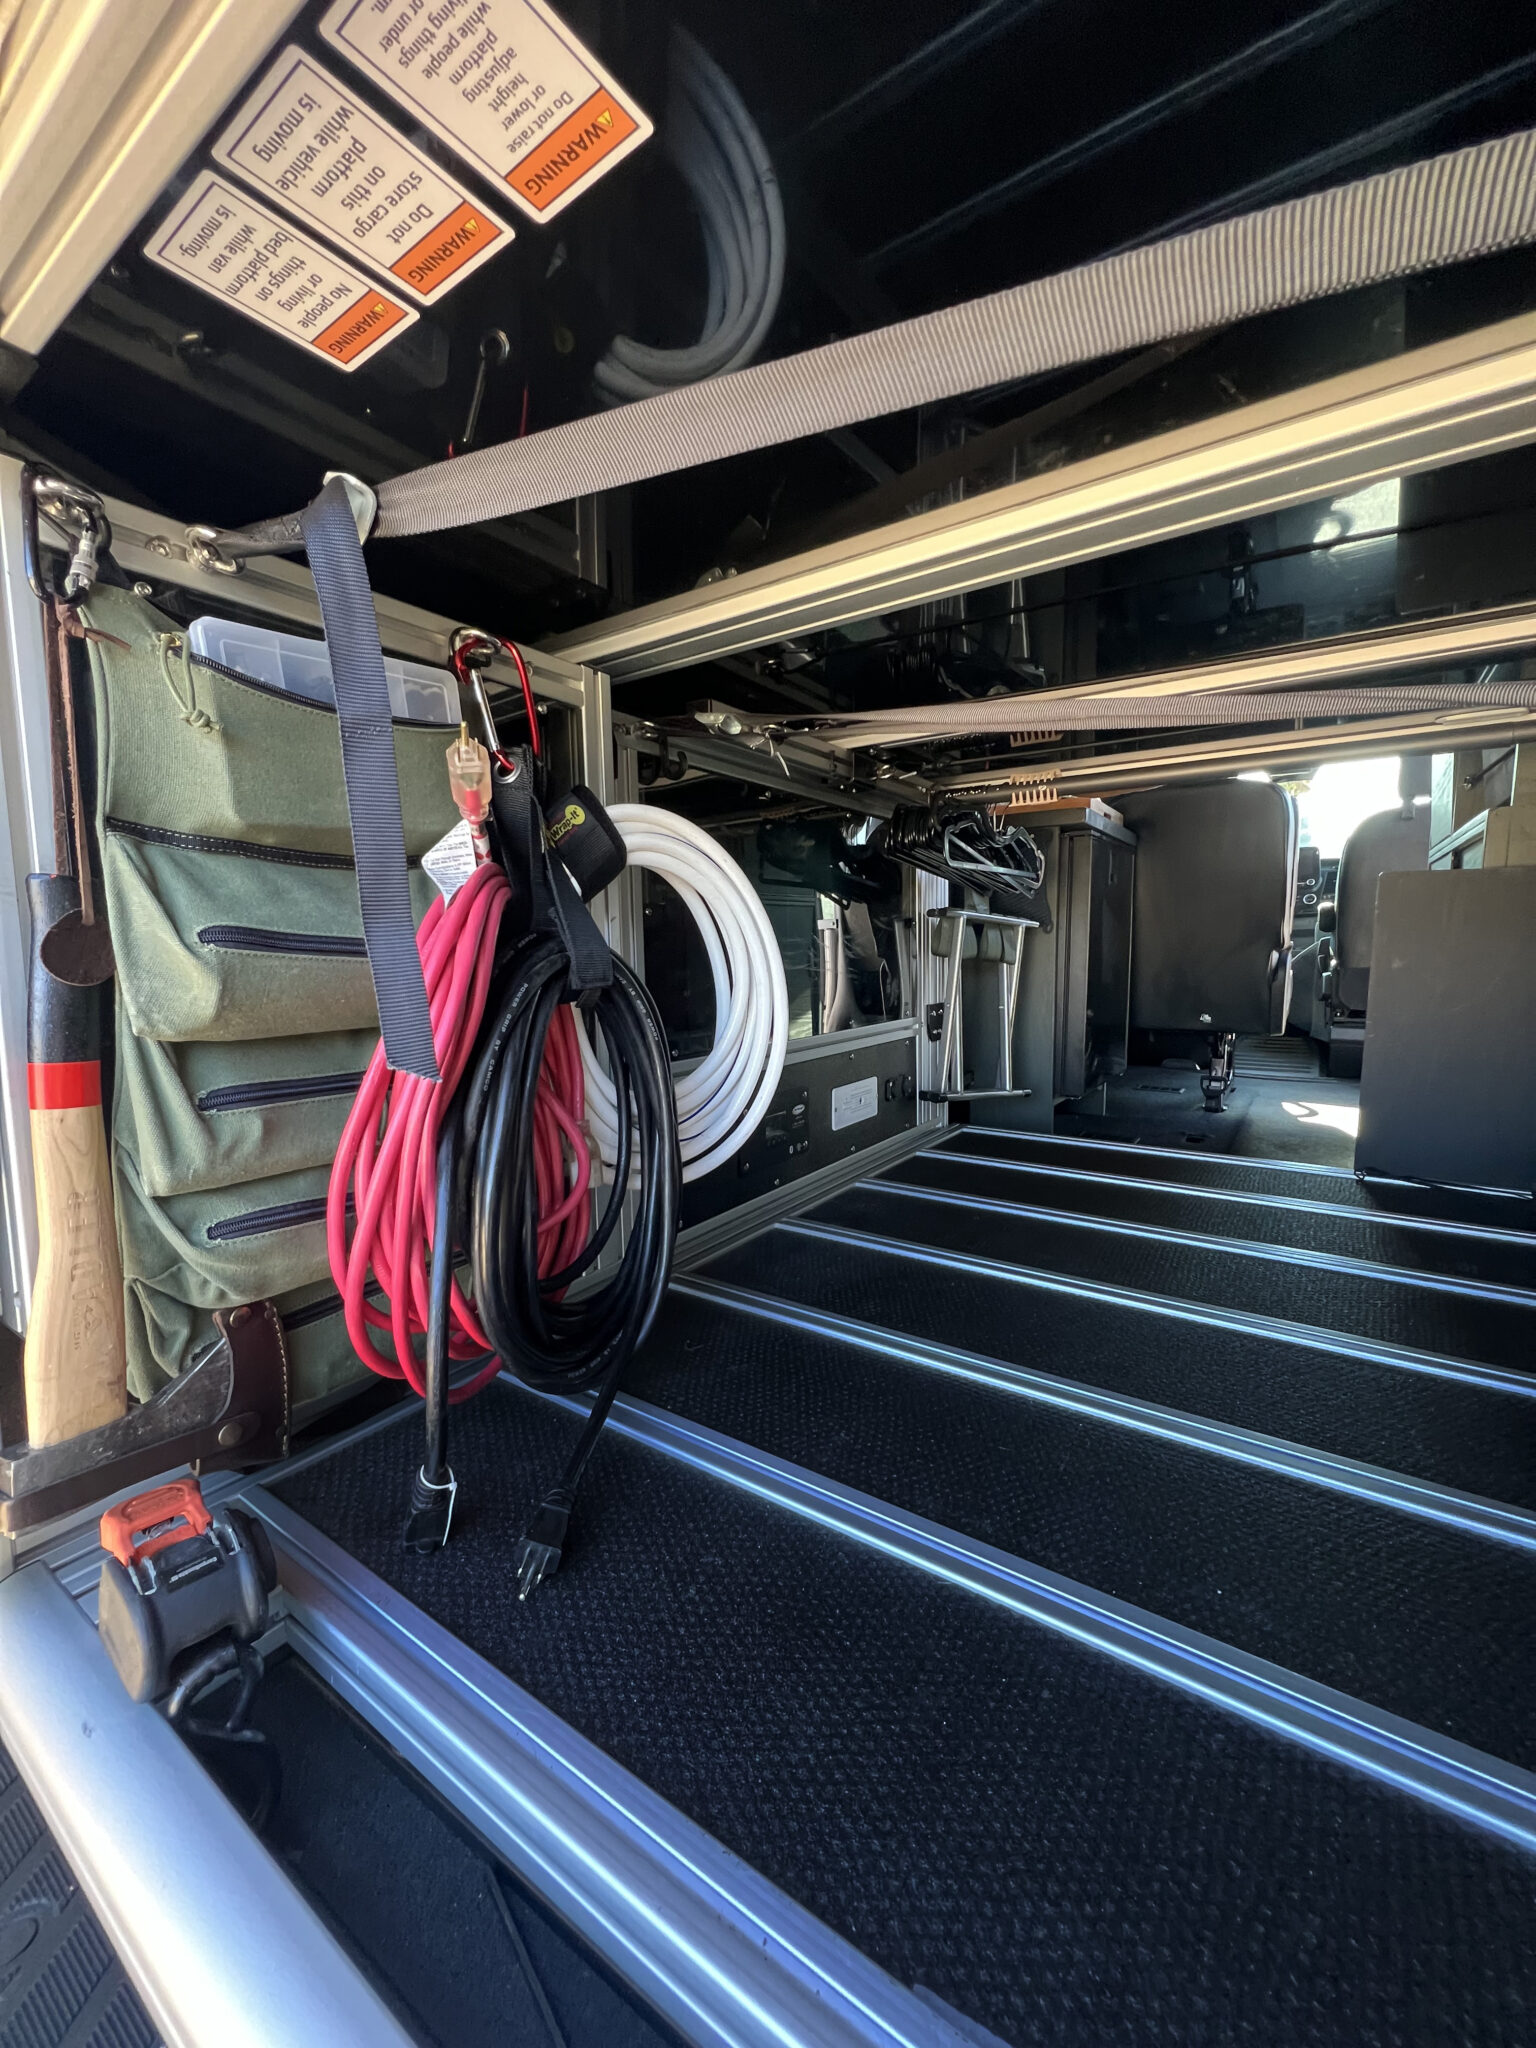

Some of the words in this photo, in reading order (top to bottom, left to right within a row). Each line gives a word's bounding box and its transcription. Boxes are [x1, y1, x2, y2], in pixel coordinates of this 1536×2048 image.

[409, 0, 424, 16] or
[457, 2, 491, 39] while
[379, 12, 412, 53] under
[398, 27, 436, 69] things
[422, 32, 460, 79] people
[449, 27, 498, 85] platform
[462, 47, 517, 103] adjusting
[298, 92, 321, 113] is
[488, 72, 529, 112] height
[532, 85, 546, 102] or
[553, 91, 574, 109] Do
[314, 105, 354, 147] while
[502, 97, 536, 131] lower
[532, 107, 555, 130] not
[252, 108, 304, 163] moving
[506, 126, 535, 153] raise
[275, 145, 320, 191] vehicle
[311, 135, 367, 197] platform
[524, 122, 608, 196] WARNING
[364, 166, 385, 186] on
[385, 171, 422, 207] store
[215, 204, 237, 220] is
[340, 184, 372, 211] this
[408, 203, 434, 223] Do
[179, 216, 223, 258] moving.
[352, 204, 389, 238] cargo
[386, 220, 412, 244] not
[224, 224, 256, 255] while
[263, 231, 294, 258] bed
[408, 227, 476, 283] WARNING
[207, 253, 232, 273] van
[225, 248, 269, 295] platform
[268, 256, 307, 289] things
[255, 286, 273, 301] on
[307, 273, 323, 288] or
[329, 282, 352, 299] No
[277, 285, 316, 312] living
[297, 295, 334, 328] people
[328, 310, 384, 353] WARNING
[550, 809, 580, 840] Wrap-It
[512, 983, 528, 1007] POWER
[501, 1014, 512, 1032] GRIP
[483, 1059, 495, 1091] CAMCO
